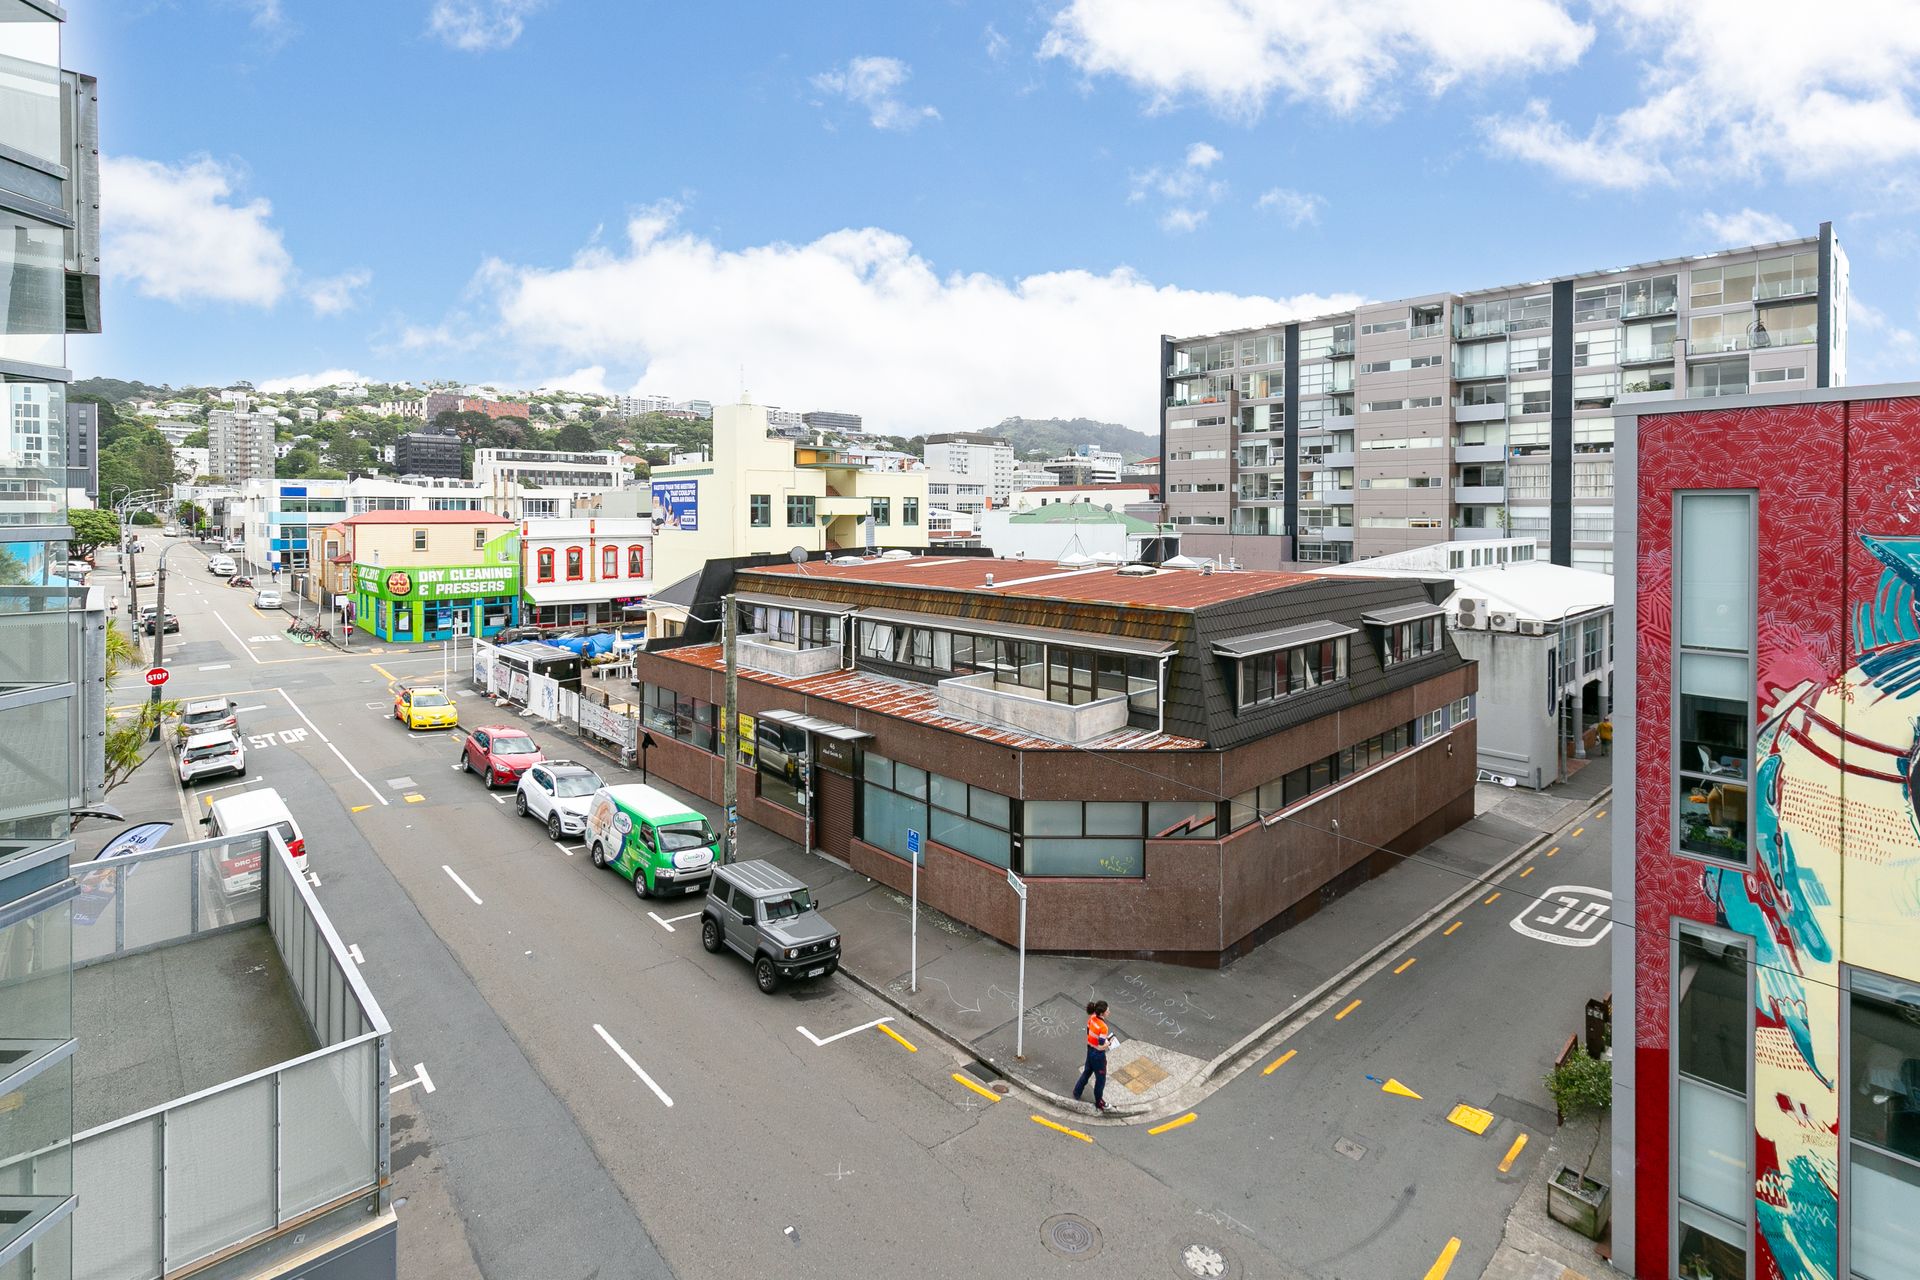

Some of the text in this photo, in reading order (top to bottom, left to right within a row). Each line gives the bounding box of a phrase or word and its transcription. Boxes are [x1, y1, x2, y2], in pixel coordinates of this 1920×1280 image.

[418, 567, 513, 582] DRY CLEANING
[418, 581, 505, 596] & PRESSERS
[147, 672, 168, 682] STOP
[248, 727, 309, 749] STOP
[1535, 896, 1610, 932] 30
